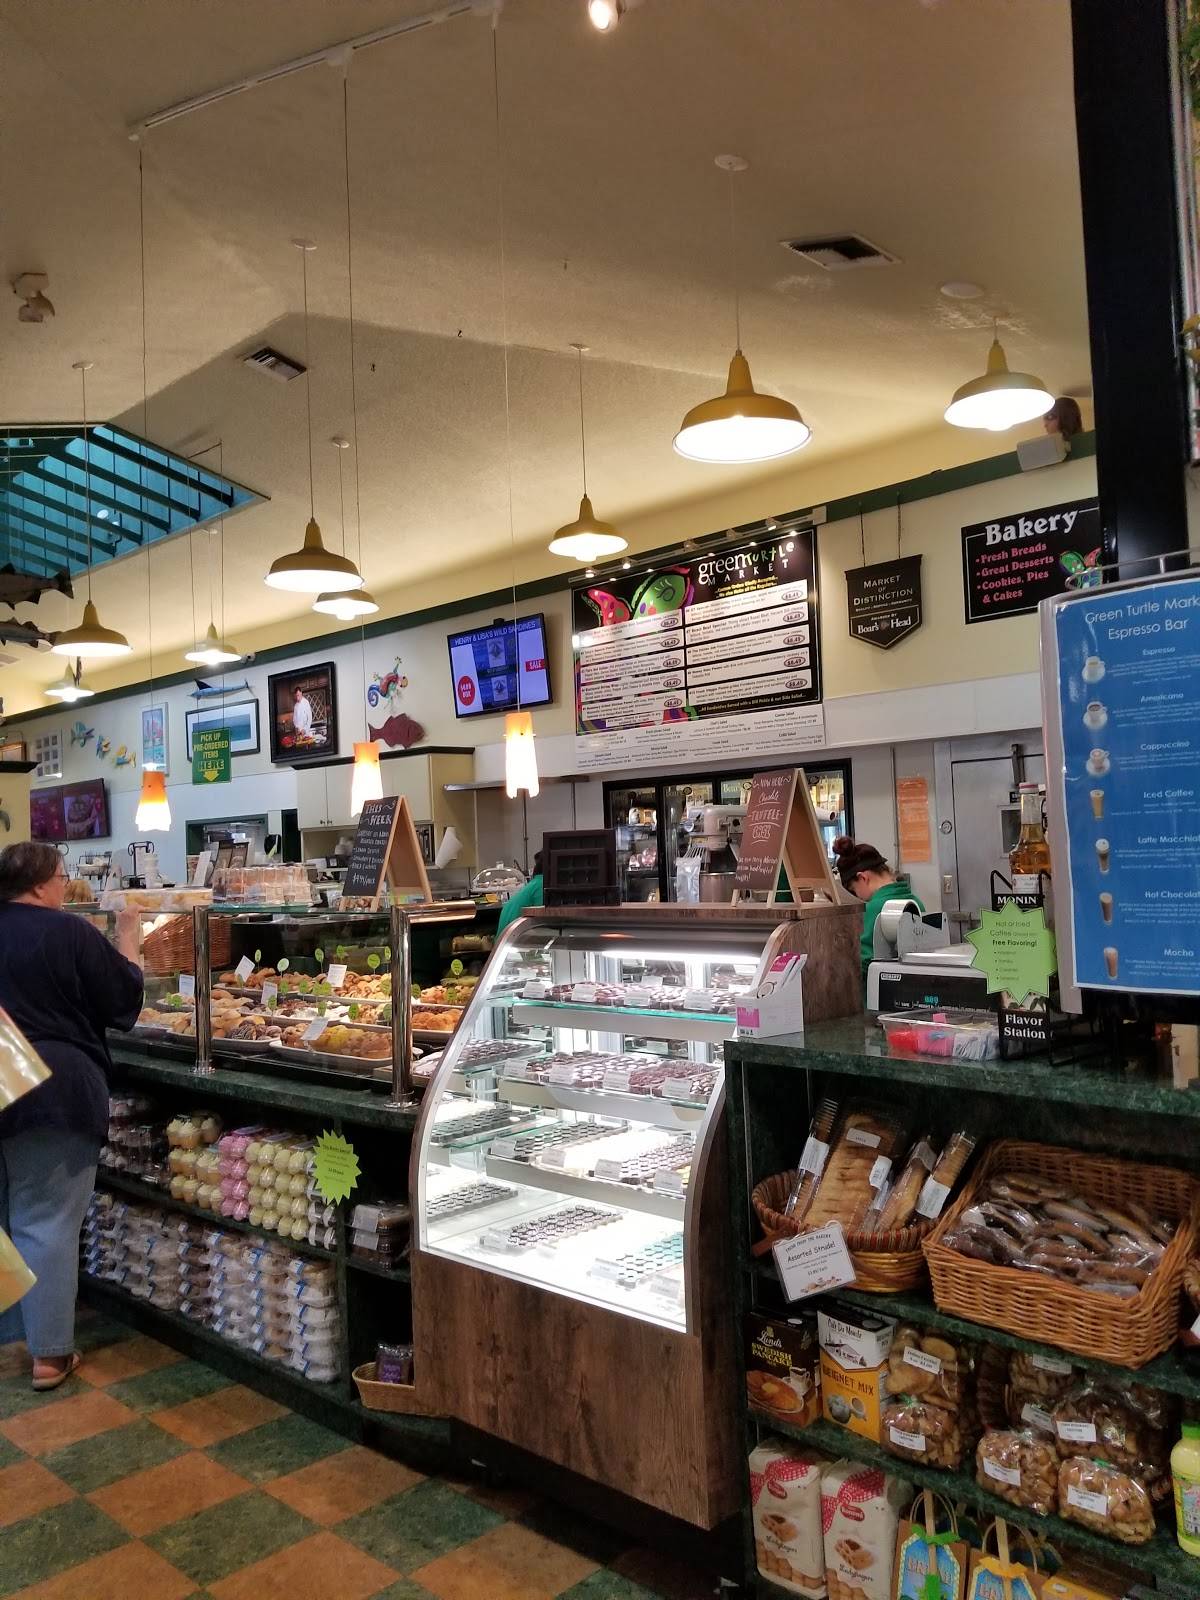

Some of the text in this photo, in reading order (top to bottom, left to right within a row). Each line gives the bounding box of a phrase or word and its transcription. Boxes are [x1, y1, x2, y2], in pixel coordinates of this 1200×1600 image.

[984, 509, 1079, 547] Bakery
[981, 542, 1047, 564] Fresh Breads
[698, 554, 747, 585] green
[707, 559, 789, 586] MARKET
[981, 555, 1055, 577] Great Desserts
[863, 574, 901, 589] MARKET
[1027, 569, 1050, 582] Pies
[853, 588, 913, 606] DISTINCTION
[983, 589, 1023, 604] & Cakes
[1085, 609, 1123, 625] Green
[1126, 600, 1160, 616] Turtle
[857, 616, 912, 634] Boar's Head
[1108, 619, 1190, 641] Espresso Bar
[455, 636, 472, 646] HENRY
[477, 630, 493, 641] LISA'S
[493, 628, 507, 637] WILD
[213, 732, 221, 740] UP
[193, 742, 229, 752] PRE-ORDERED
[1140, 740, 1190, 752] Cappuccino
[203, 750, 219, 759] ITEMS
[198, 760, 225, 771] HERE
[1143, 788, 1194, 799] Iced Coffee
[370, 815, 392, 826] WEEK
[1136, 835, 1157, 844] Latte
[1144, 891, 1159, 899] Hot
[1007, 939, 1037, 947] Flavoring!
[1163, 947, 1194, 957] Mocha
[1005, 1013, 1043, 1027] Flavor
[1003, 1026, 1046, 1040] Station
[787, 1249, 813, 1263] Assorted
[814, 1241, 836, 1254] Strudel
[845, 1324, 863, 1339] Monde
[752, 1342, 792, 1360] SWEDISH
[752, 1350, 793, 1367] PANCAKE
[822, 1364, 874, 1396] BEIGNET MIX
